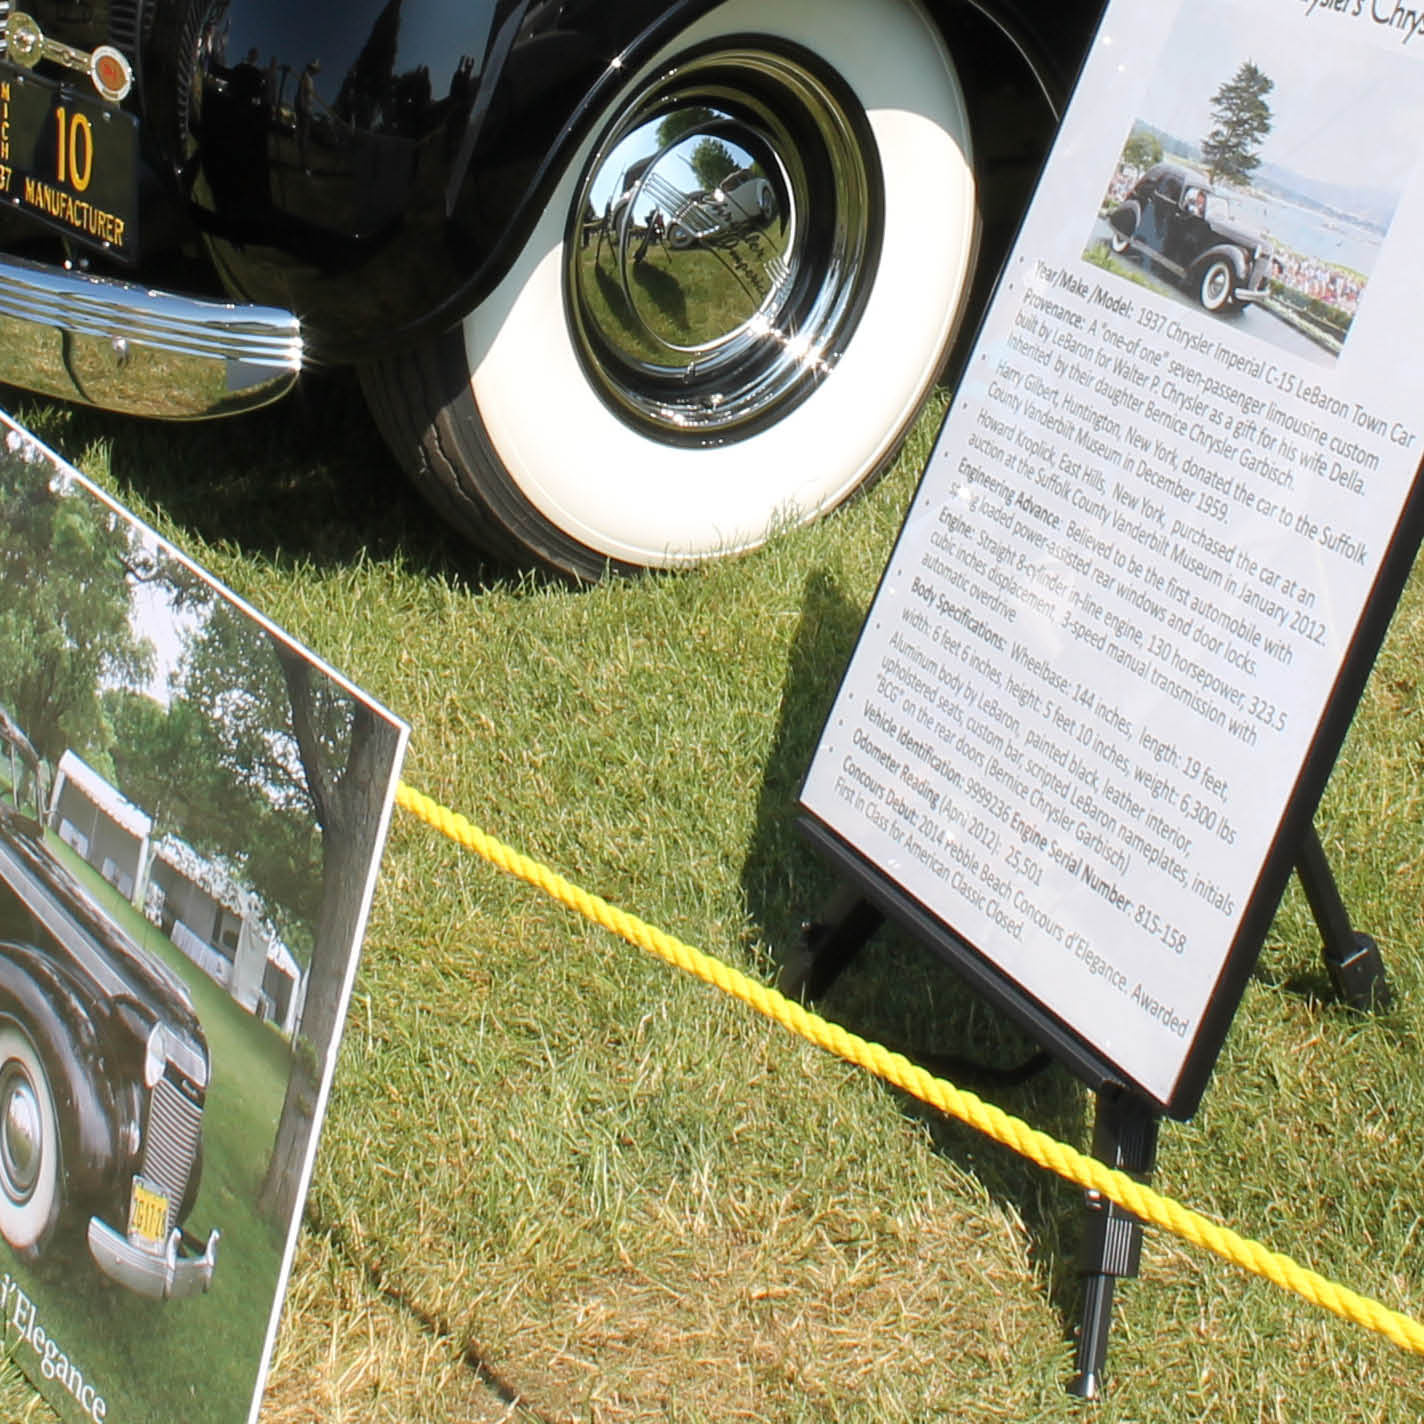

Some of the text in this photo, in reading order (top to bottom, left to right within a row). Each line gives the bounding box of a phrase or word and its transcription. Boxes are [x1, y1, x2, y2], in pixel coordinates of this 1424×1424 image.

[0, 81, 11, 160] MICH
[55, 105, 94, 192] 10
[24, 176, 125, 247] MANUFACTURER
[1033, 262, 1088, 299] Year/Make
[1136, 308, 1165, 334] 1937
[1164, 322, 1212, 356] Chrysler
[1213, 343, 1265, 380] Imperial
[1263, 367, 1295, 394] C-15
[1295, 380, 1348, 419] LeBaron
[1350, 407, 1387, 437] Town
[1388, 424, 1414, 449] Car
[1051, 328, 1093, 361] LeBaron
[1093, 348, 1112, 370] for
[1110, 358, 1149, 389] Walter
[1160, 382, 1209, 418] Chrysler
[1231, 420, 1260, 442] gift
[1256, 428, 1277, 452] for
[1297, 452, 1327, 476] wife
[1067, 363, 1094, 389] their
[1093, 375, 1144, 414] daughter
[1143, 401, 1188, 436] Bernice
[1187, 424, 1238, 462] Chrysler
[1168, 361, 1264, 416] seven-passenger
[1265, 402, 1327, 446] limousine
[1329, 438, 1378, 470] custom
[1015, 457, 1034, 480] the
[1034, 469, 1072, 501] Suffolk
[1110, 511, 1170, 556] Vanderbilt
[1169, 544, 1222, 586] Museum
[1238, 583, 1288, 629] January
[1057, 453, 1083, 478] East
[1111, 482, 1139, 510] New
[1170, 519, 1236, 563] purchased
[1258, 567, 1281, 589] car
[1074, 428, 1122, 465] Museum
[1135, 460, 1195, 505] December
[1124, 427, 1150, 453] New
[1181, 455, 1233, 495] donated
[1232, 482, 1254, 507] the
[1255, 498, 1276, 519] car
[1294, 514, 1317, 540] the
[1318, 528, 1368, 565] Suffolk
[922, 554, 1015, 622] automatic overdrive
[957, 458, 1014, 507] Engineering
[1065, 521, 1113, 560] Believed
[1143, 566, 1163, 590] the
[1165, 578, 1190, 605] first
[1190, 597, 1260, 647] automobile
[1262, 639, 1293, 665] with
[976, 531, 1017, 566] Straight
[1147, 634, 1172, 661] 130
[1247, 697, 1286, 732] 323.5
[978, 496, 1014, 529] loaded
[1011, 522, 1091, 576] power-assisted
[1090, 568, 1114, 590] rear
[1115, 583, 1166, 621] windows
[1167, 613, 1192, 636] and
[1192, 623, 1223, 655] door
[911, 578, 935, 610] Body
[1073, 684, 1094, 710] 144
[954, 543, 1258, 746] inches 3-speed manual with
[852, 728, 900, 775] Odometer
[899, 763, 940, 811] Reading
[1004, 845, 1043, 885] 25,501
[880, 657, 938, 704] upholstered
[1024, 759, 1070, 799] scripted
[1069, 787, 1117, 833] LeBaron
[1190, 872, 1234, 917] initials
[916, 706, 932, 729] the
[934, 723, 954, 745] rear
[983, 756, 1027, 799] (Bernice
[1029, 789, 1073, 832] Chrysler
[1075, 822, 1130, 878] Garbisch)
[937, 664, 962, 698] body
[1024, 731, 1068, 767] painted
[1102, 778, 1143, 821] leather
[939, 631, 962, 656] feet
[1051, 706, 1077, 735] feet
[1179, 794, 1216, 830] 6,300
[1216, 816, 1235, 844] lbs
[841, 755, 885, 799] Concours
[918, 815, 945, 846] 2014
[979, 862, 1014, 900] Beach
[1131, 983, 1188, 1038] Awarded
[862, 701, 896, 737] Vehicle
[965, 778, 1011, 822] 9999236
[1010, 811, 1047, 851] Engine
[1048, 840, 1082, 876] Serial
[1134, 905, 1186, 954] 815-158
[888, 820, 904, 844] for
[903, 834, 950, 881] American
[950, 871, 985, 910] Classic
